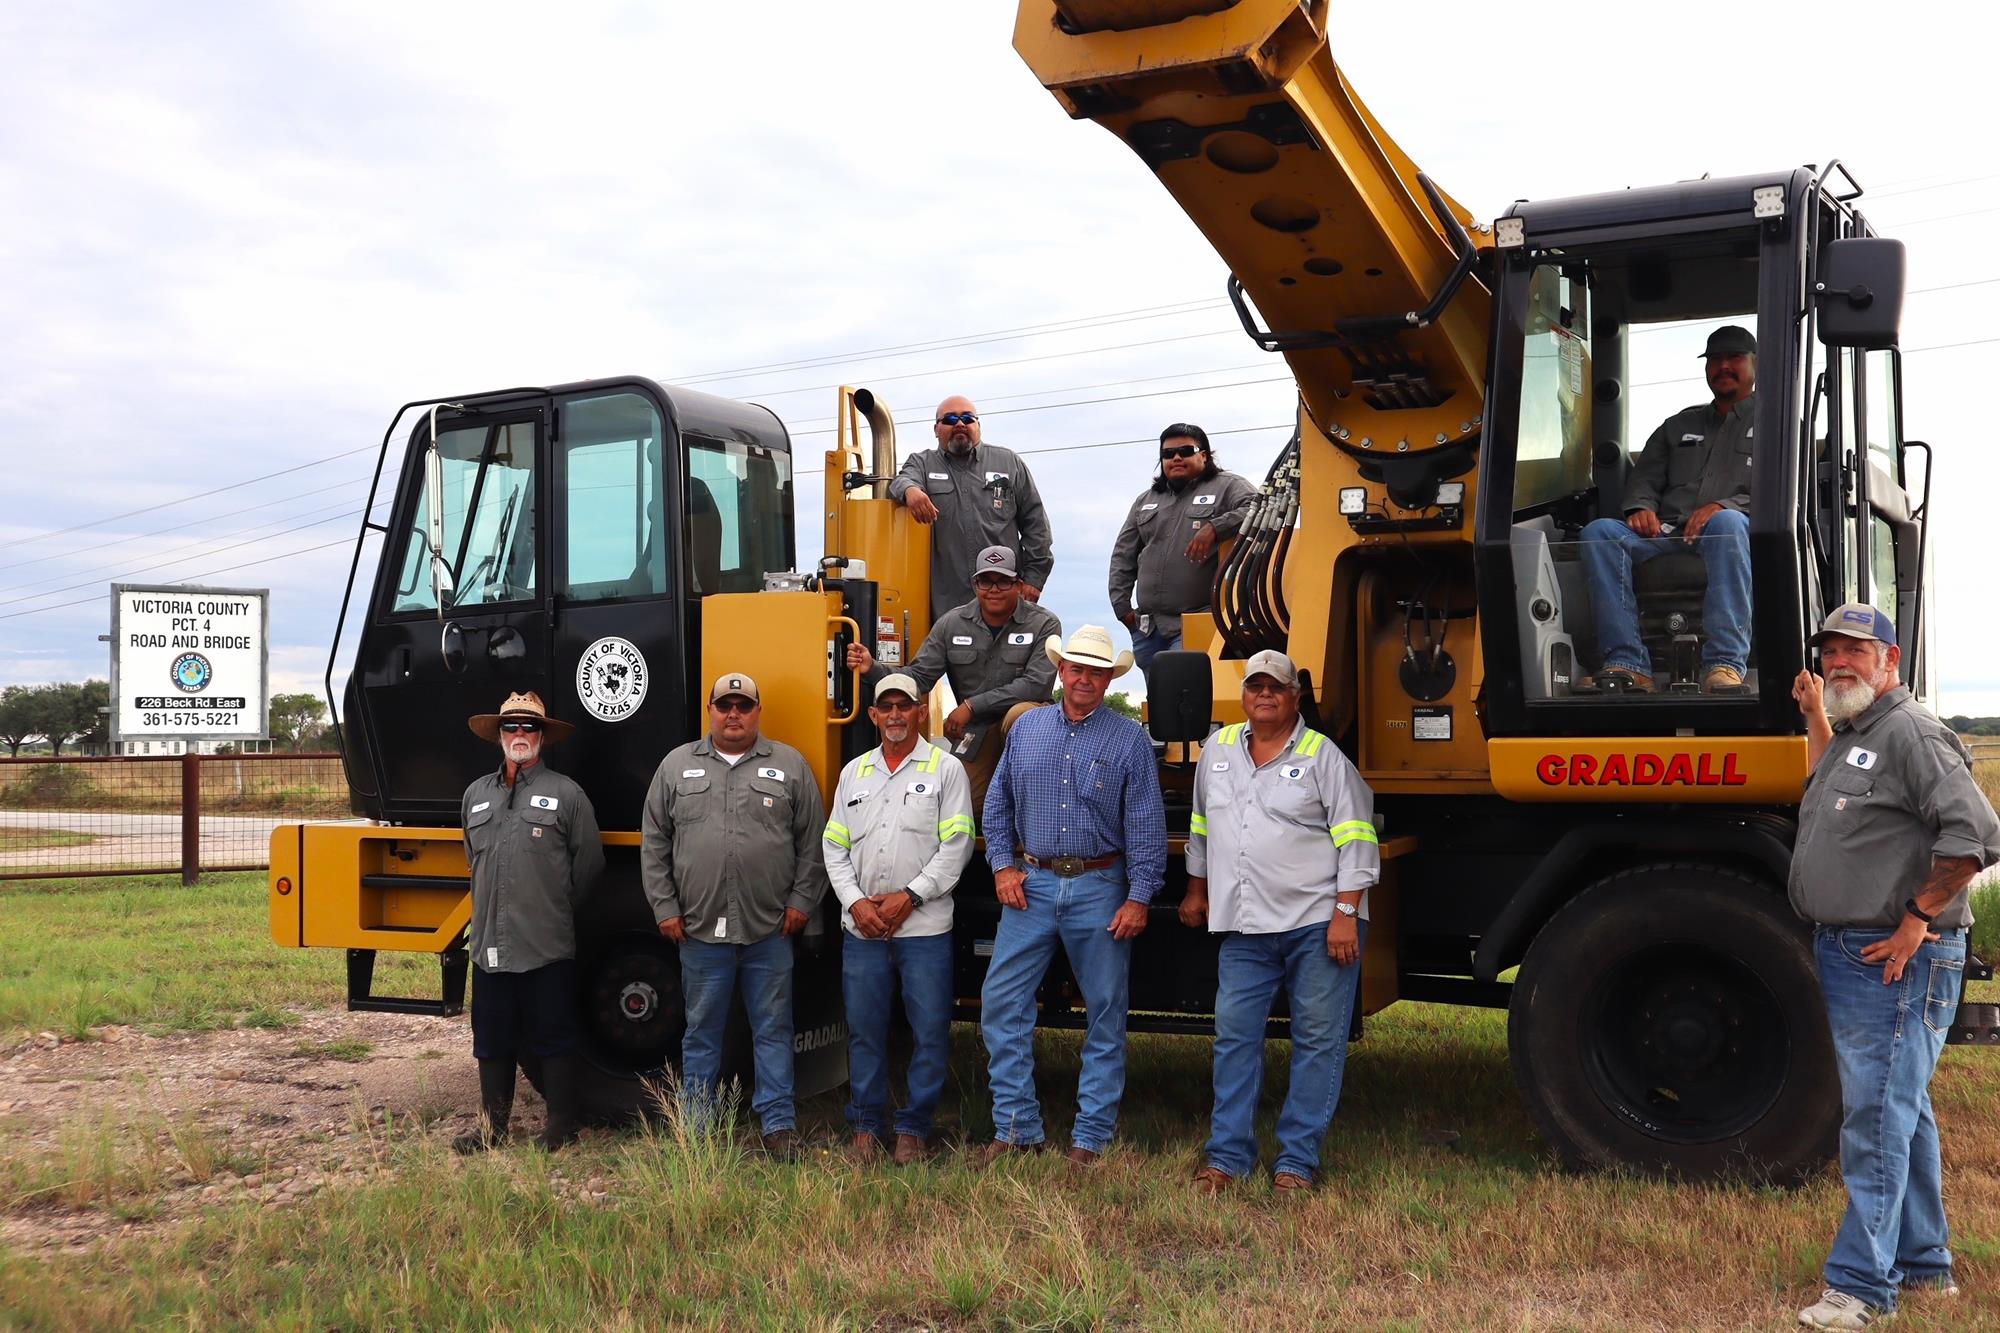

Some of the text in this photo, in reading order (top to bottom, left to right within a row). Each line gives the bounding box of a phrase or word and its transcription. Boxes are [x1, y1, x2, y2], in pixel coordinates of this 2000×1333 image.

[132, 600, 250, 616] VICTORIA COUNTY
[172, 618, 211, 631] PCT. 4
[130, 634, 251, 649] ROAD AND BRIDGE
[582, 643, 643, 698] COUNTY OF VICTORIA
[140, 698, 240, 708] 226 Beck Rd. East
[597, 700, 631, 715] TEXAS
[143, 713, 238, 726] 361-575-5221
[1536, 753, 1747, 786] GRADALL
